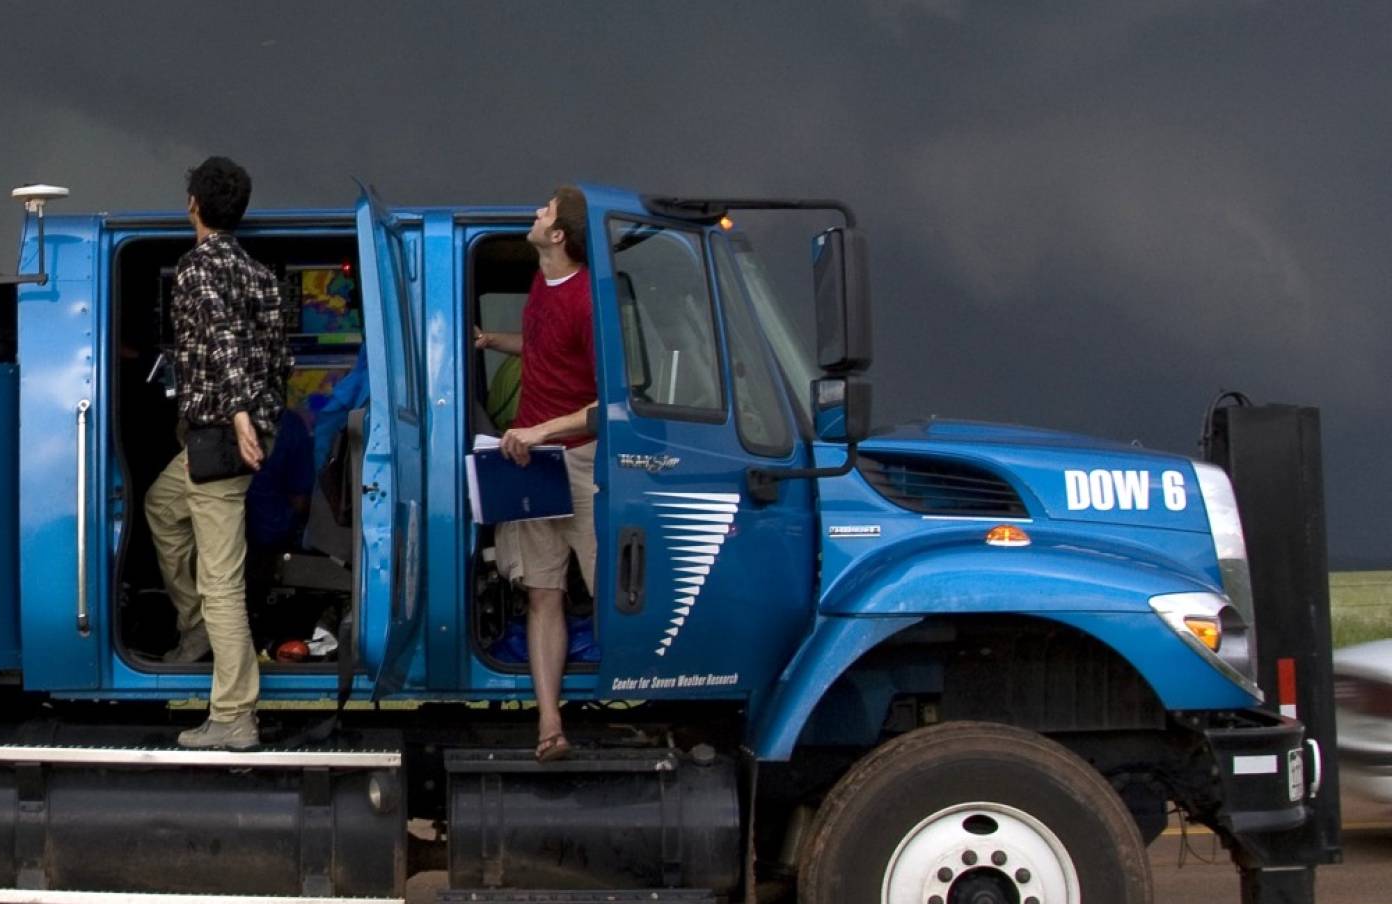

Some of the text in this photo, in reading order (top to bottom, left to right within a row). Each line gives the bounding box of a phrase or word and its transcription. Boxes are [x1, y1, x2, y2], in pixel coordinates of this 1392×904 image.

[1064, 469, 1187, 511] DOW 6
[612, 672, 738, 690] Center for Severe Weather Research
